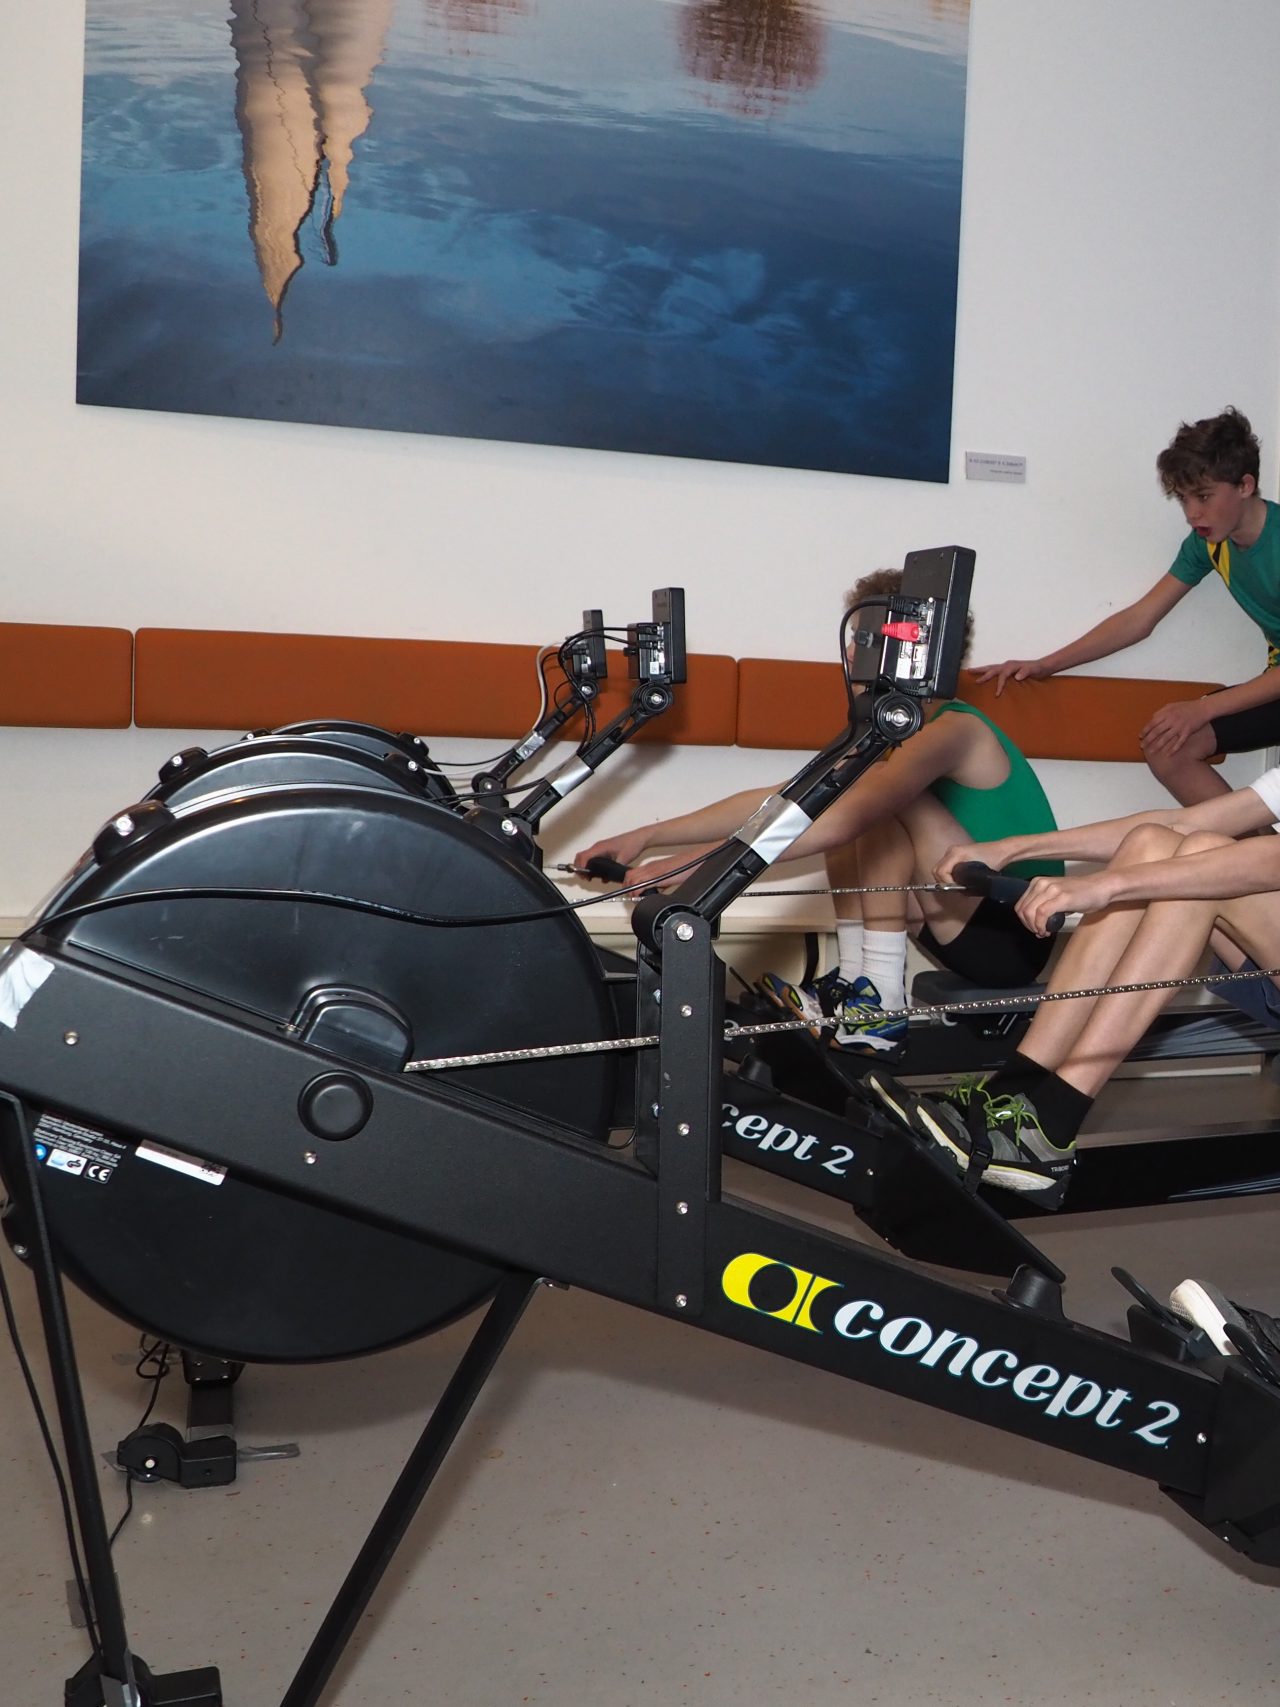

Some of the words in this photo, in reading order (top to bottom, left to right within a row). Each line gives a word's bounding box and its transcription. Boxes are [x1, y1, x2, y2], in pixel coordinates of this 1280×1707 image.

[87, 1165, 111, 1181] CE
[820, 1144, 855, 1175] 2
[833, 1299, 1133, 1428] concept
[1132, 1400, 1181, 1445] 2
